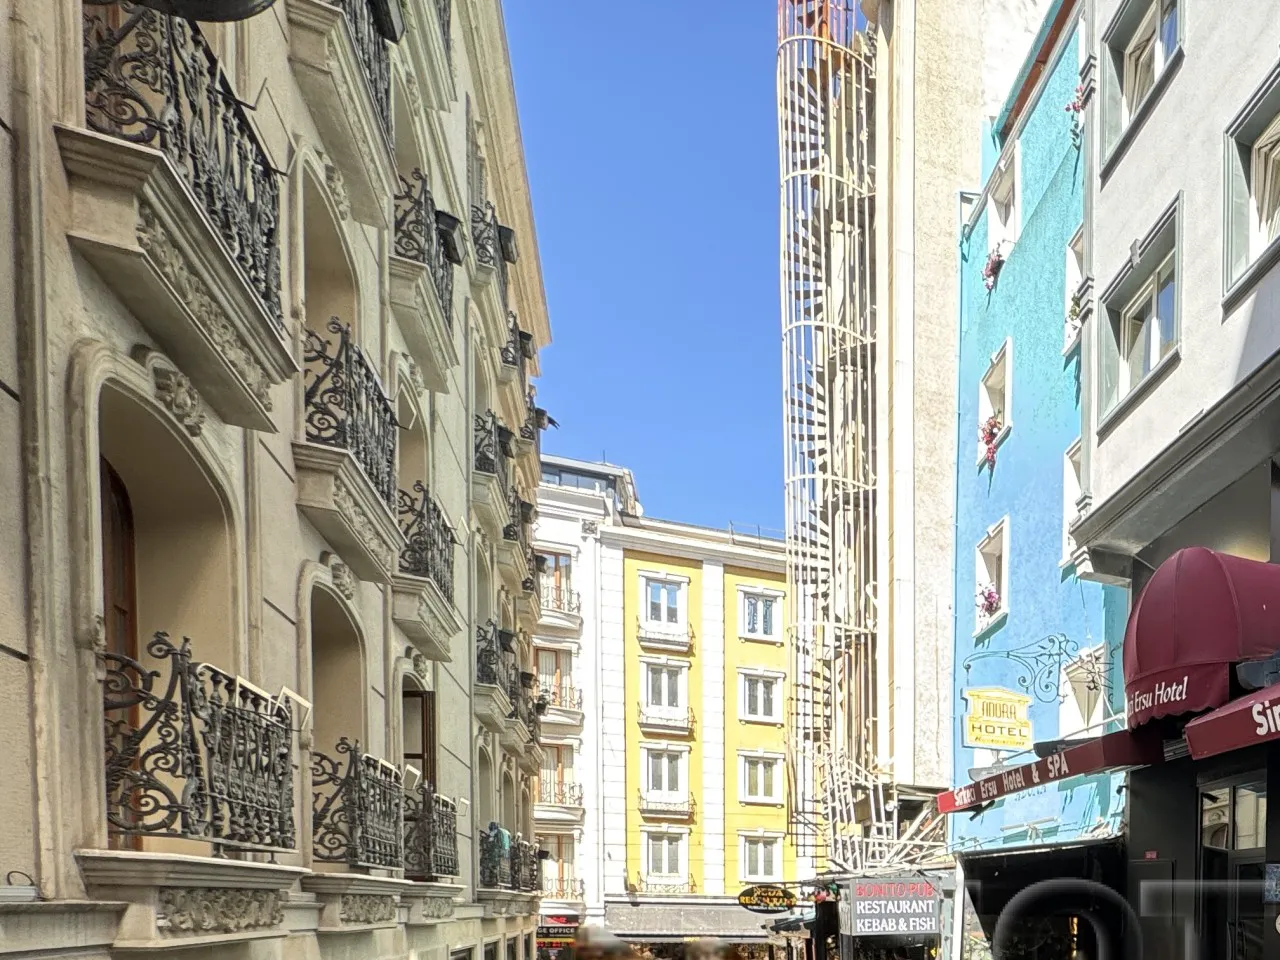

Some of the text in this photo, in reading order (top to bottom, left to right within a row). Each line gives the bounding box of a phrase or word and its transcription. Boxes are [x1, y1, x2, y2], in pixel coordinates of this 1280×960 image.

[1134, 690, 1153, 713] Ersu
[1154, 675, 1189, 706] Hotel
[971, 723, 1028, 738] HOTEL
[980, 779, 998, 799] Ersu
[1002, 766, 1026, 793] Hotel
[1030, 762, 1041, 784] &
[1047, 751, 1070, 779] SPA
[855, 881, 935, 898] BONITO PUB
[856, 900, 935, 914] RESTAURANT
[856, 917, 936, 932] KEBAB & FISH
